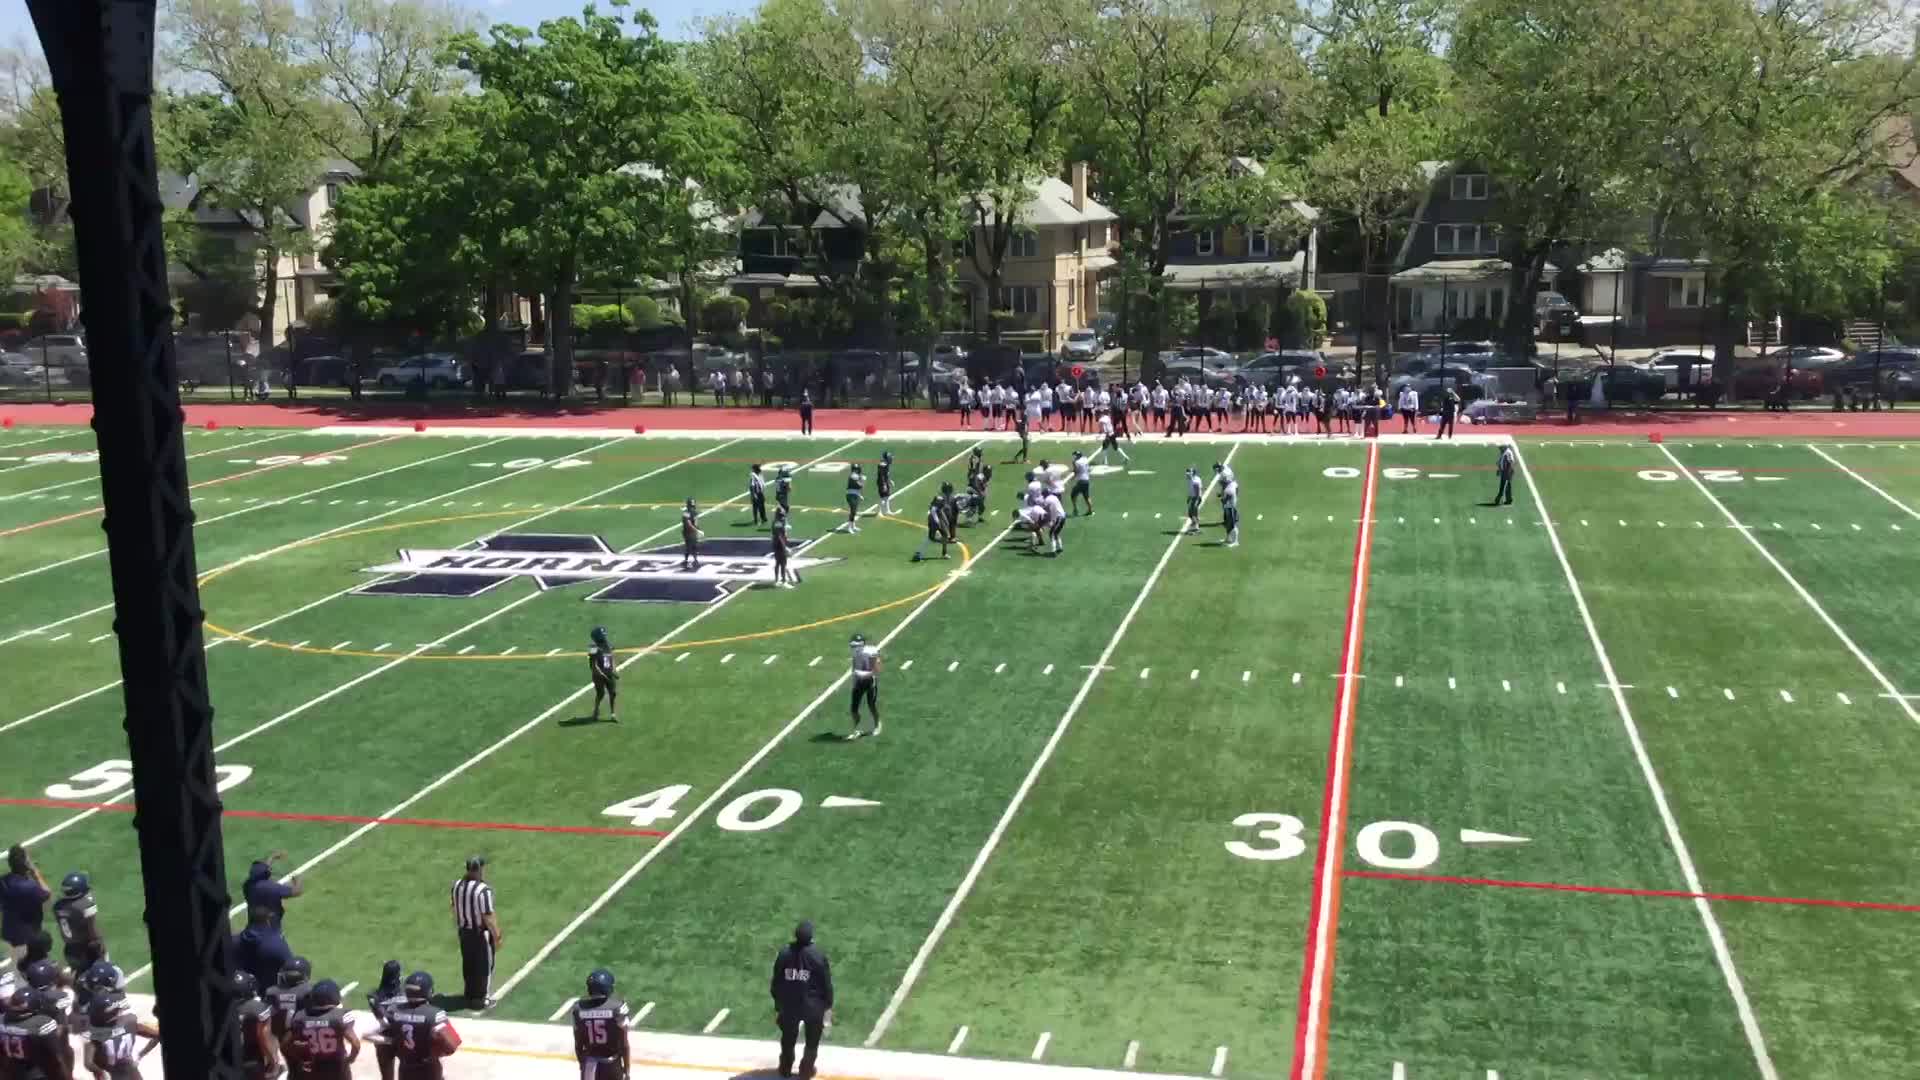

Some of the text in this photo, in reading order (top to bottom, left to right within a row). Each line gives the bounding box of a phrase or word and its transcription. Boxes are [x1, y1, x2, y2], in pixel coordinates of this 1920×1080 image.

[425, 555, 770, 574] HORNETS
[600, 783, 804, 831] 40
[1223, 812, 1440, 869] 30
[302, 1028, 338, 1054] 36
[402, 1023, 415, 1049] 3
[585, 1019, 607, 1044] 15
